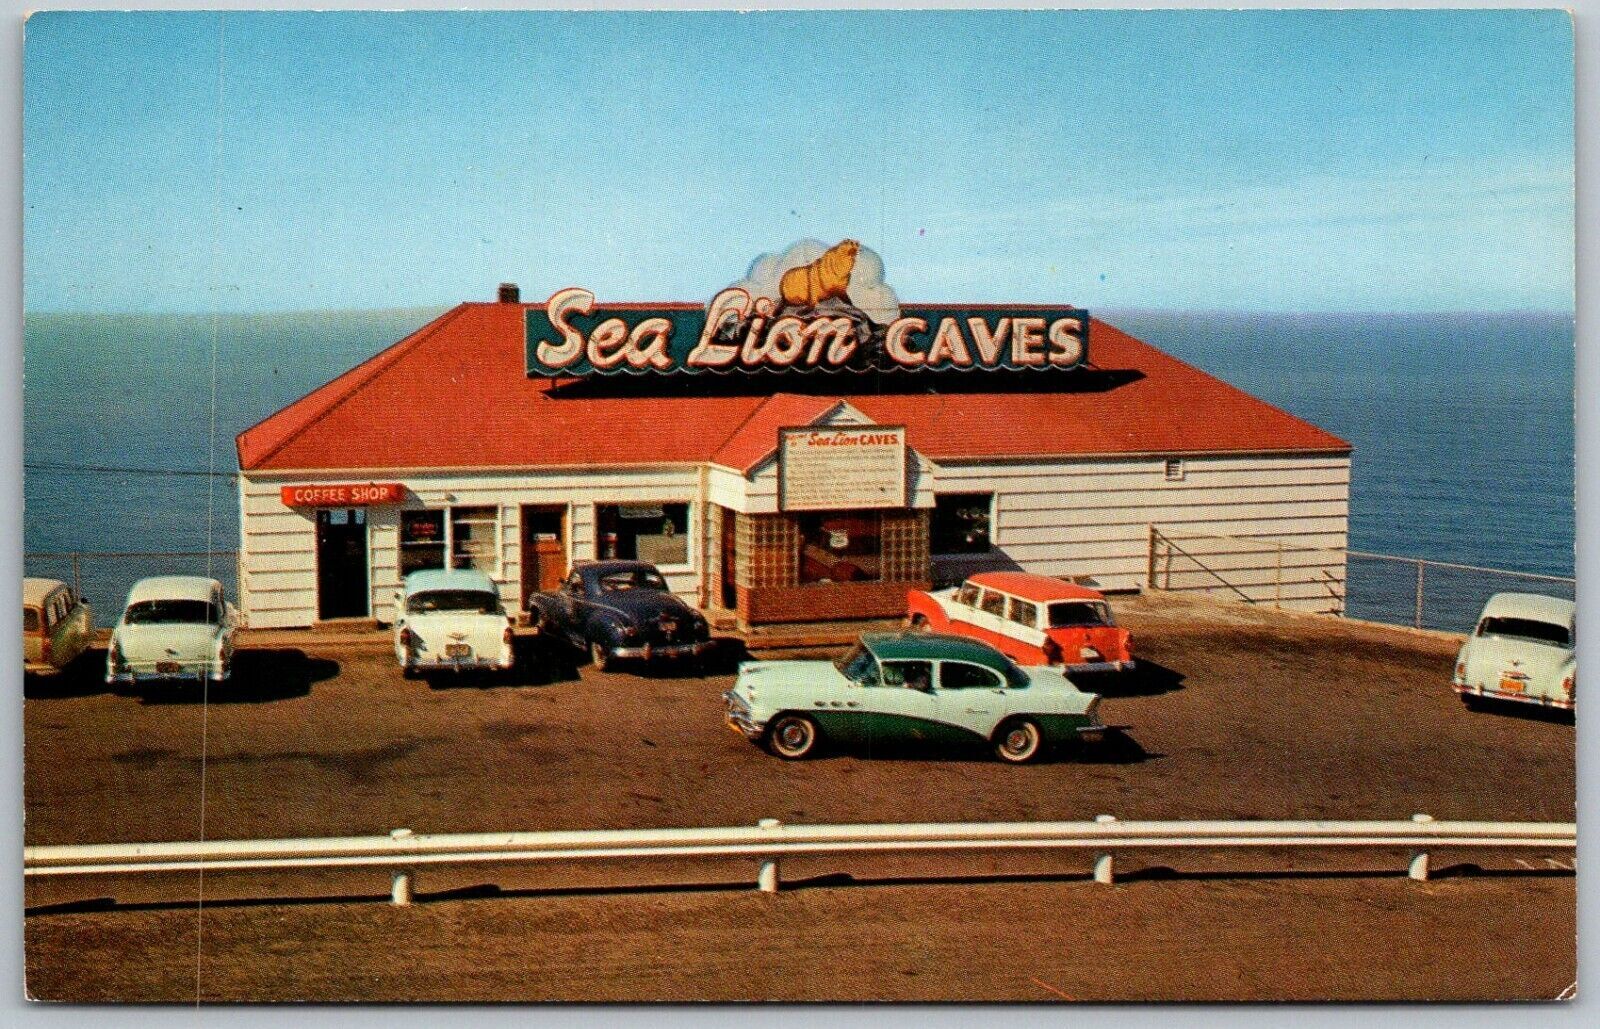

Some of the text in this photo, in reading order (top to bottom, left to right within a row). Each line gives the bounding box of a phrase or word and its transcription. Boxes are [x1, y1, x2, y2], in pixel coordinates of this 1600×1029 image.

[536, 287, 1084, 369] Sea Lion CAVES
[808, 431, 830, 446] Sea
[859, 434, 899, 446] CAVES
[294, 486, 389, 502] COFFEE SHOP
